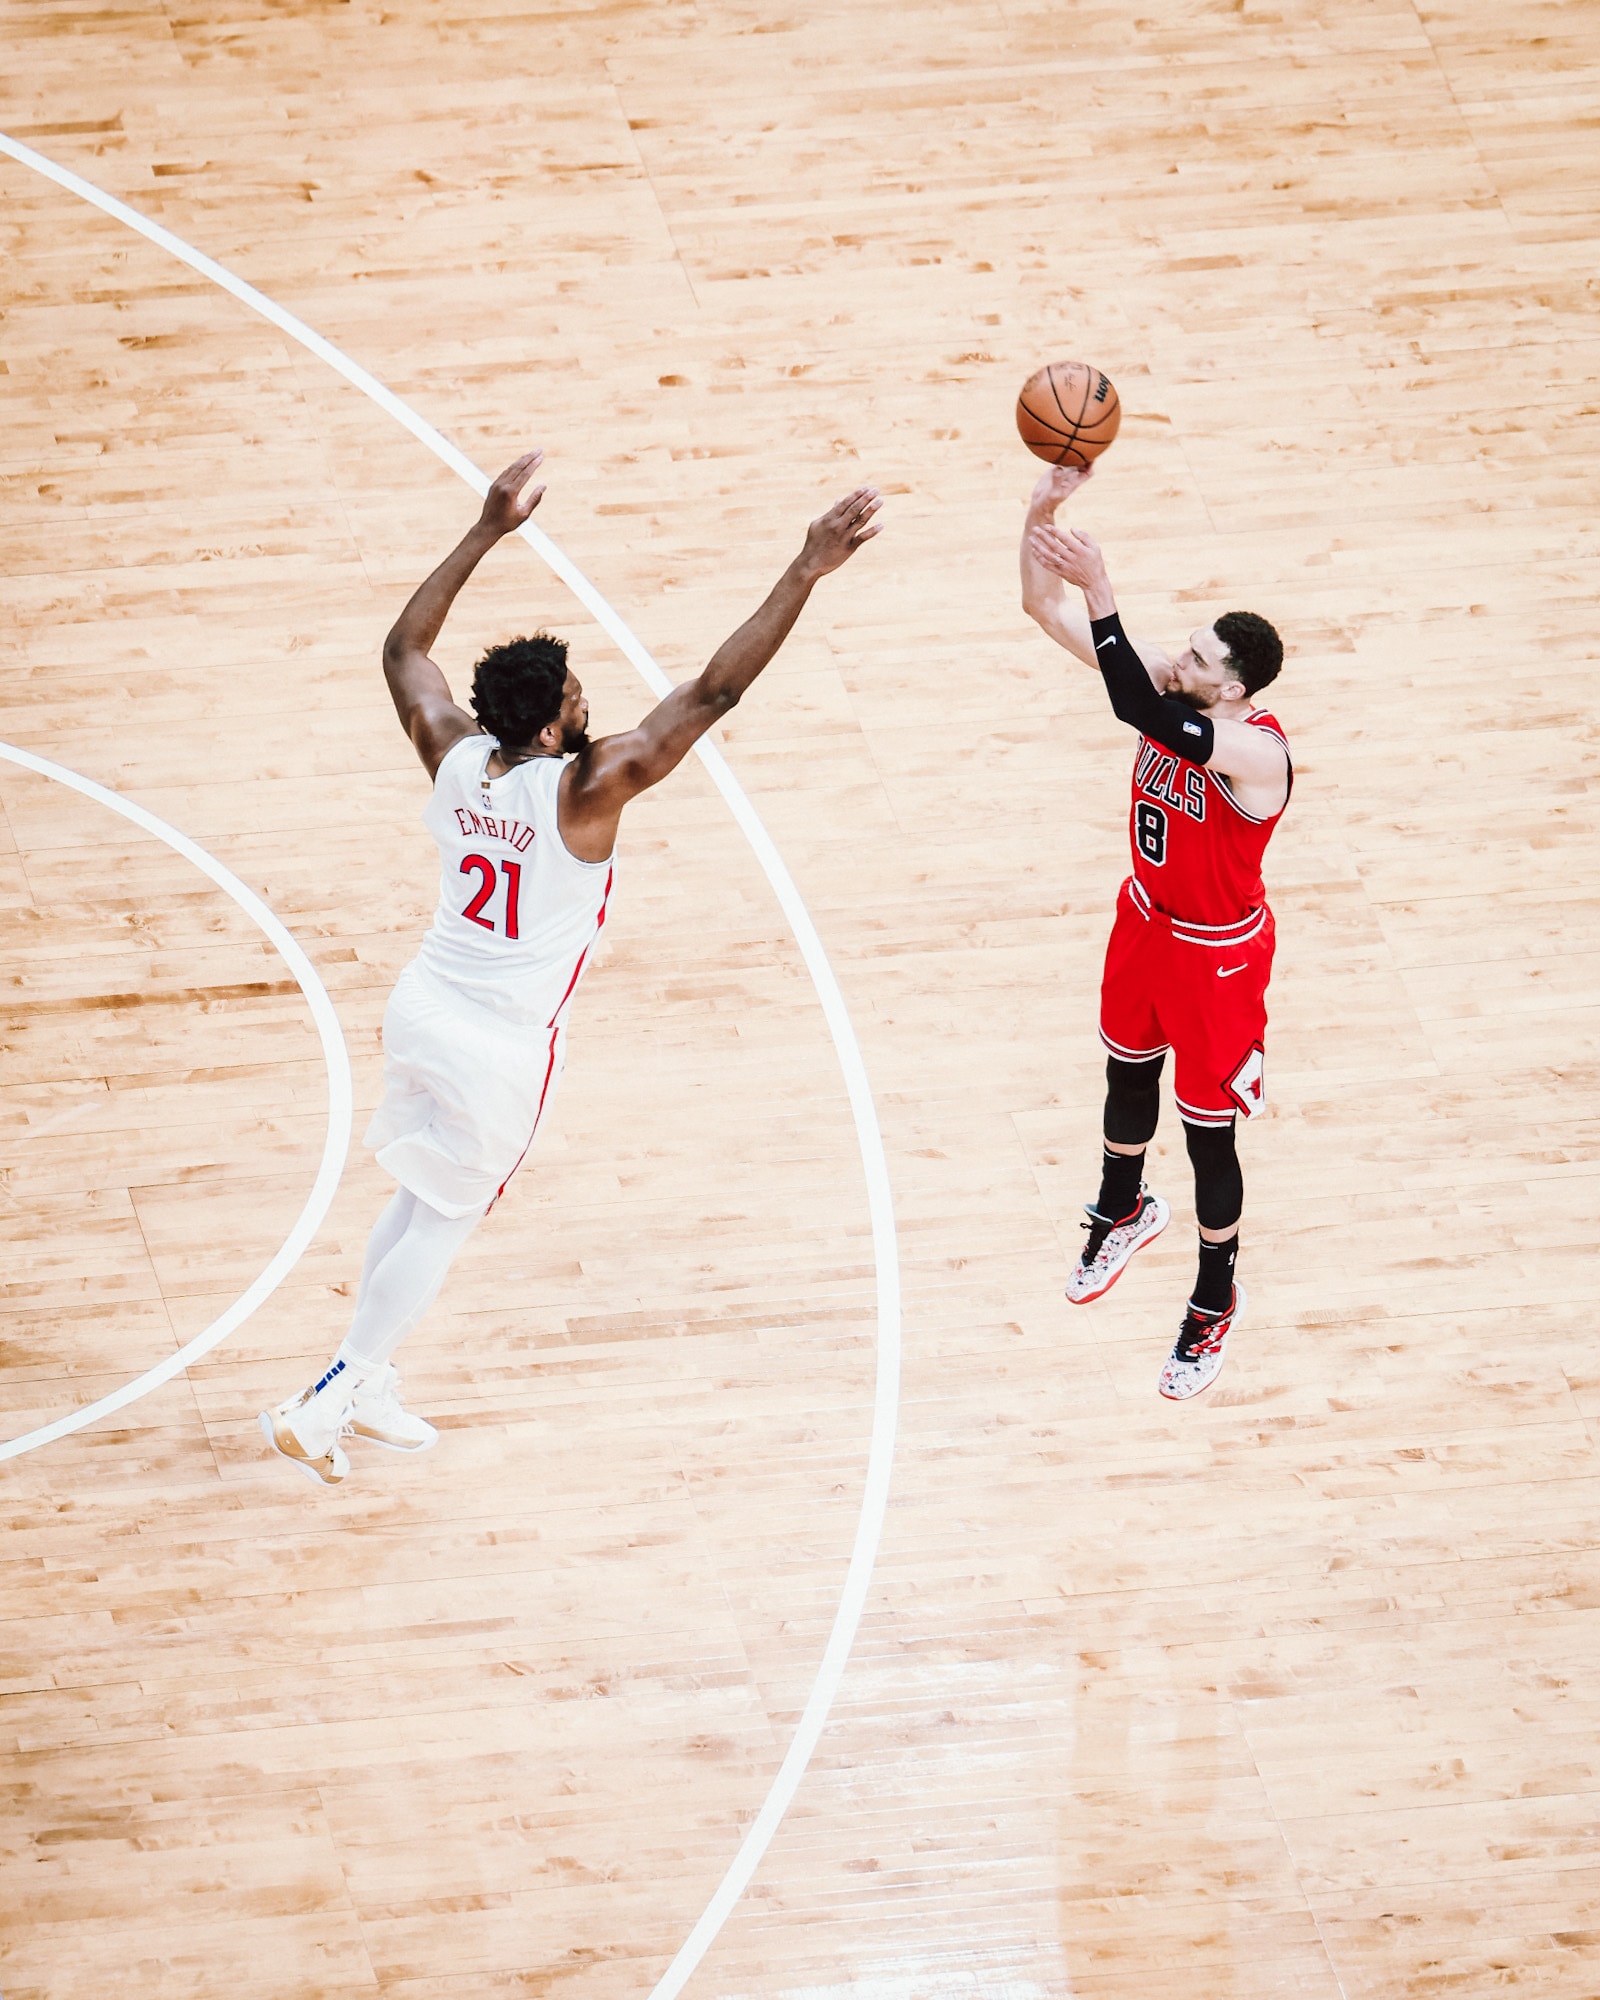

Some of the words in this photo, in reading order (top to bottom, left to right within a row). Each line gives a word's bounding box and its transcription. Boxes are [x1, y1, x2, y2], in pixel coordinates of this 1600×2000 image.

[454, 808, 535, 852] EMBIID
[1135, 800, 1168, 867] 8
[460, 853, 521, 940] 21
